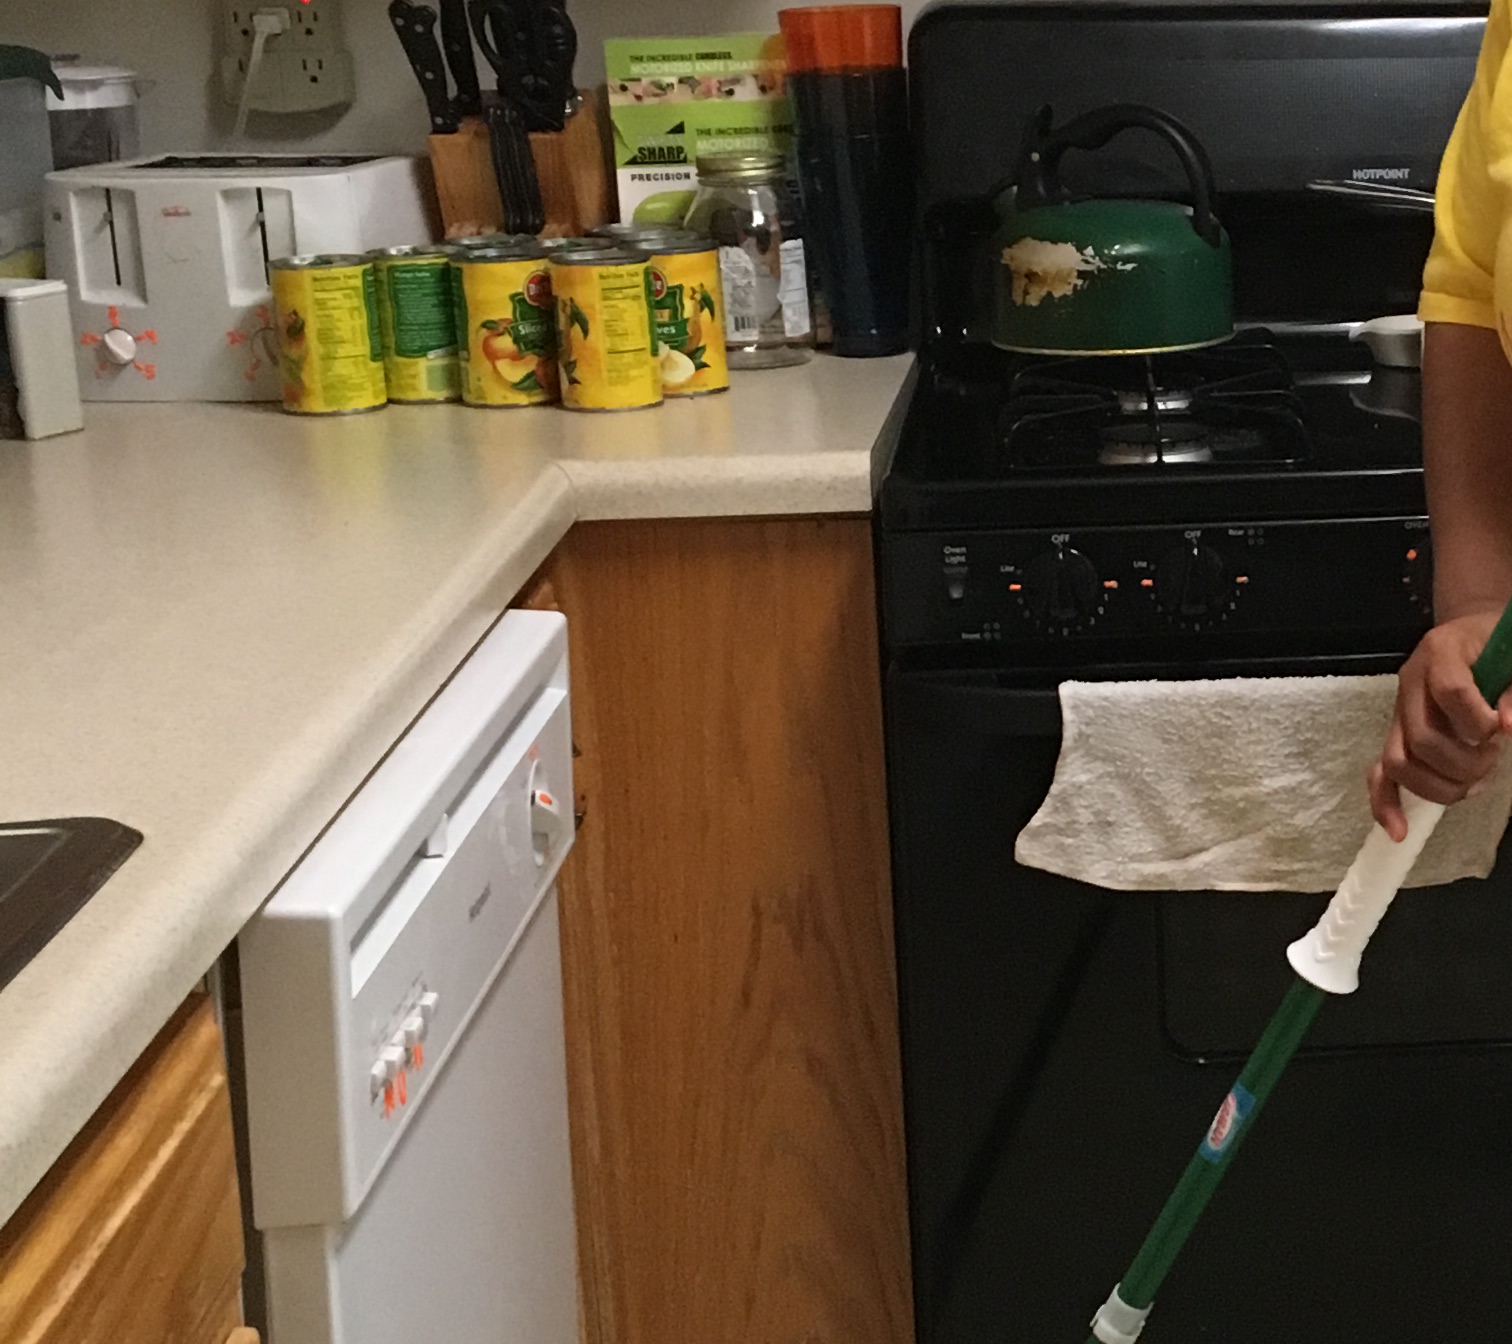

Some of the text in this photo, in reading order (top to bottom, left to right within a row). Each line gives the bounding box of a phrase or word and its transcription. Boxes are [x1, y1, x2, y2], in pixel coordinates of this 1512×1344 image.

[637, 145, 686, 162] SHARP
[630, 172, 691, 182] PRECISION
[1352, 168, 1411, 180] HOTPOINT
